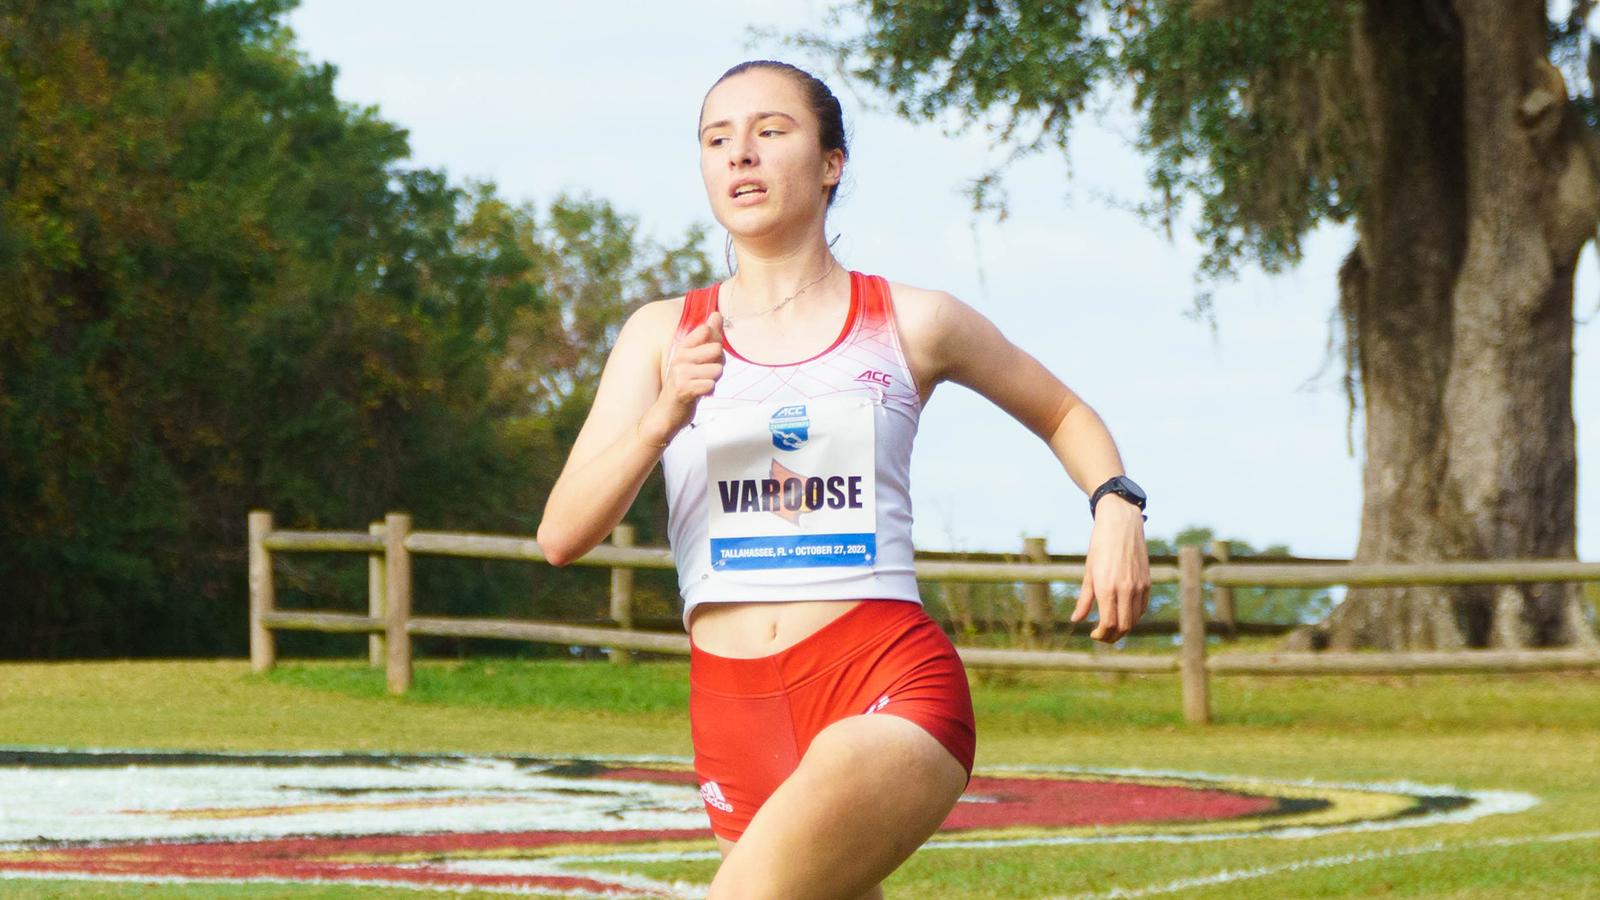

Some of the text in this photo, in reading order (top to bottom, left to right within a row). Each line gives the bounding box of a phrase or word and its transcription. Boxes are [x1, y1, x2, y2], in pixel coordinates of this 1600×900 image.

[857, 370, 892, 385] ACC
[777, 406, 804, 417] ACC
[718, 475, 863, 513] VAROOSE
[720, 544, 866, 559] TALLAHASSEE, FL OCTOBER 27, 2023
